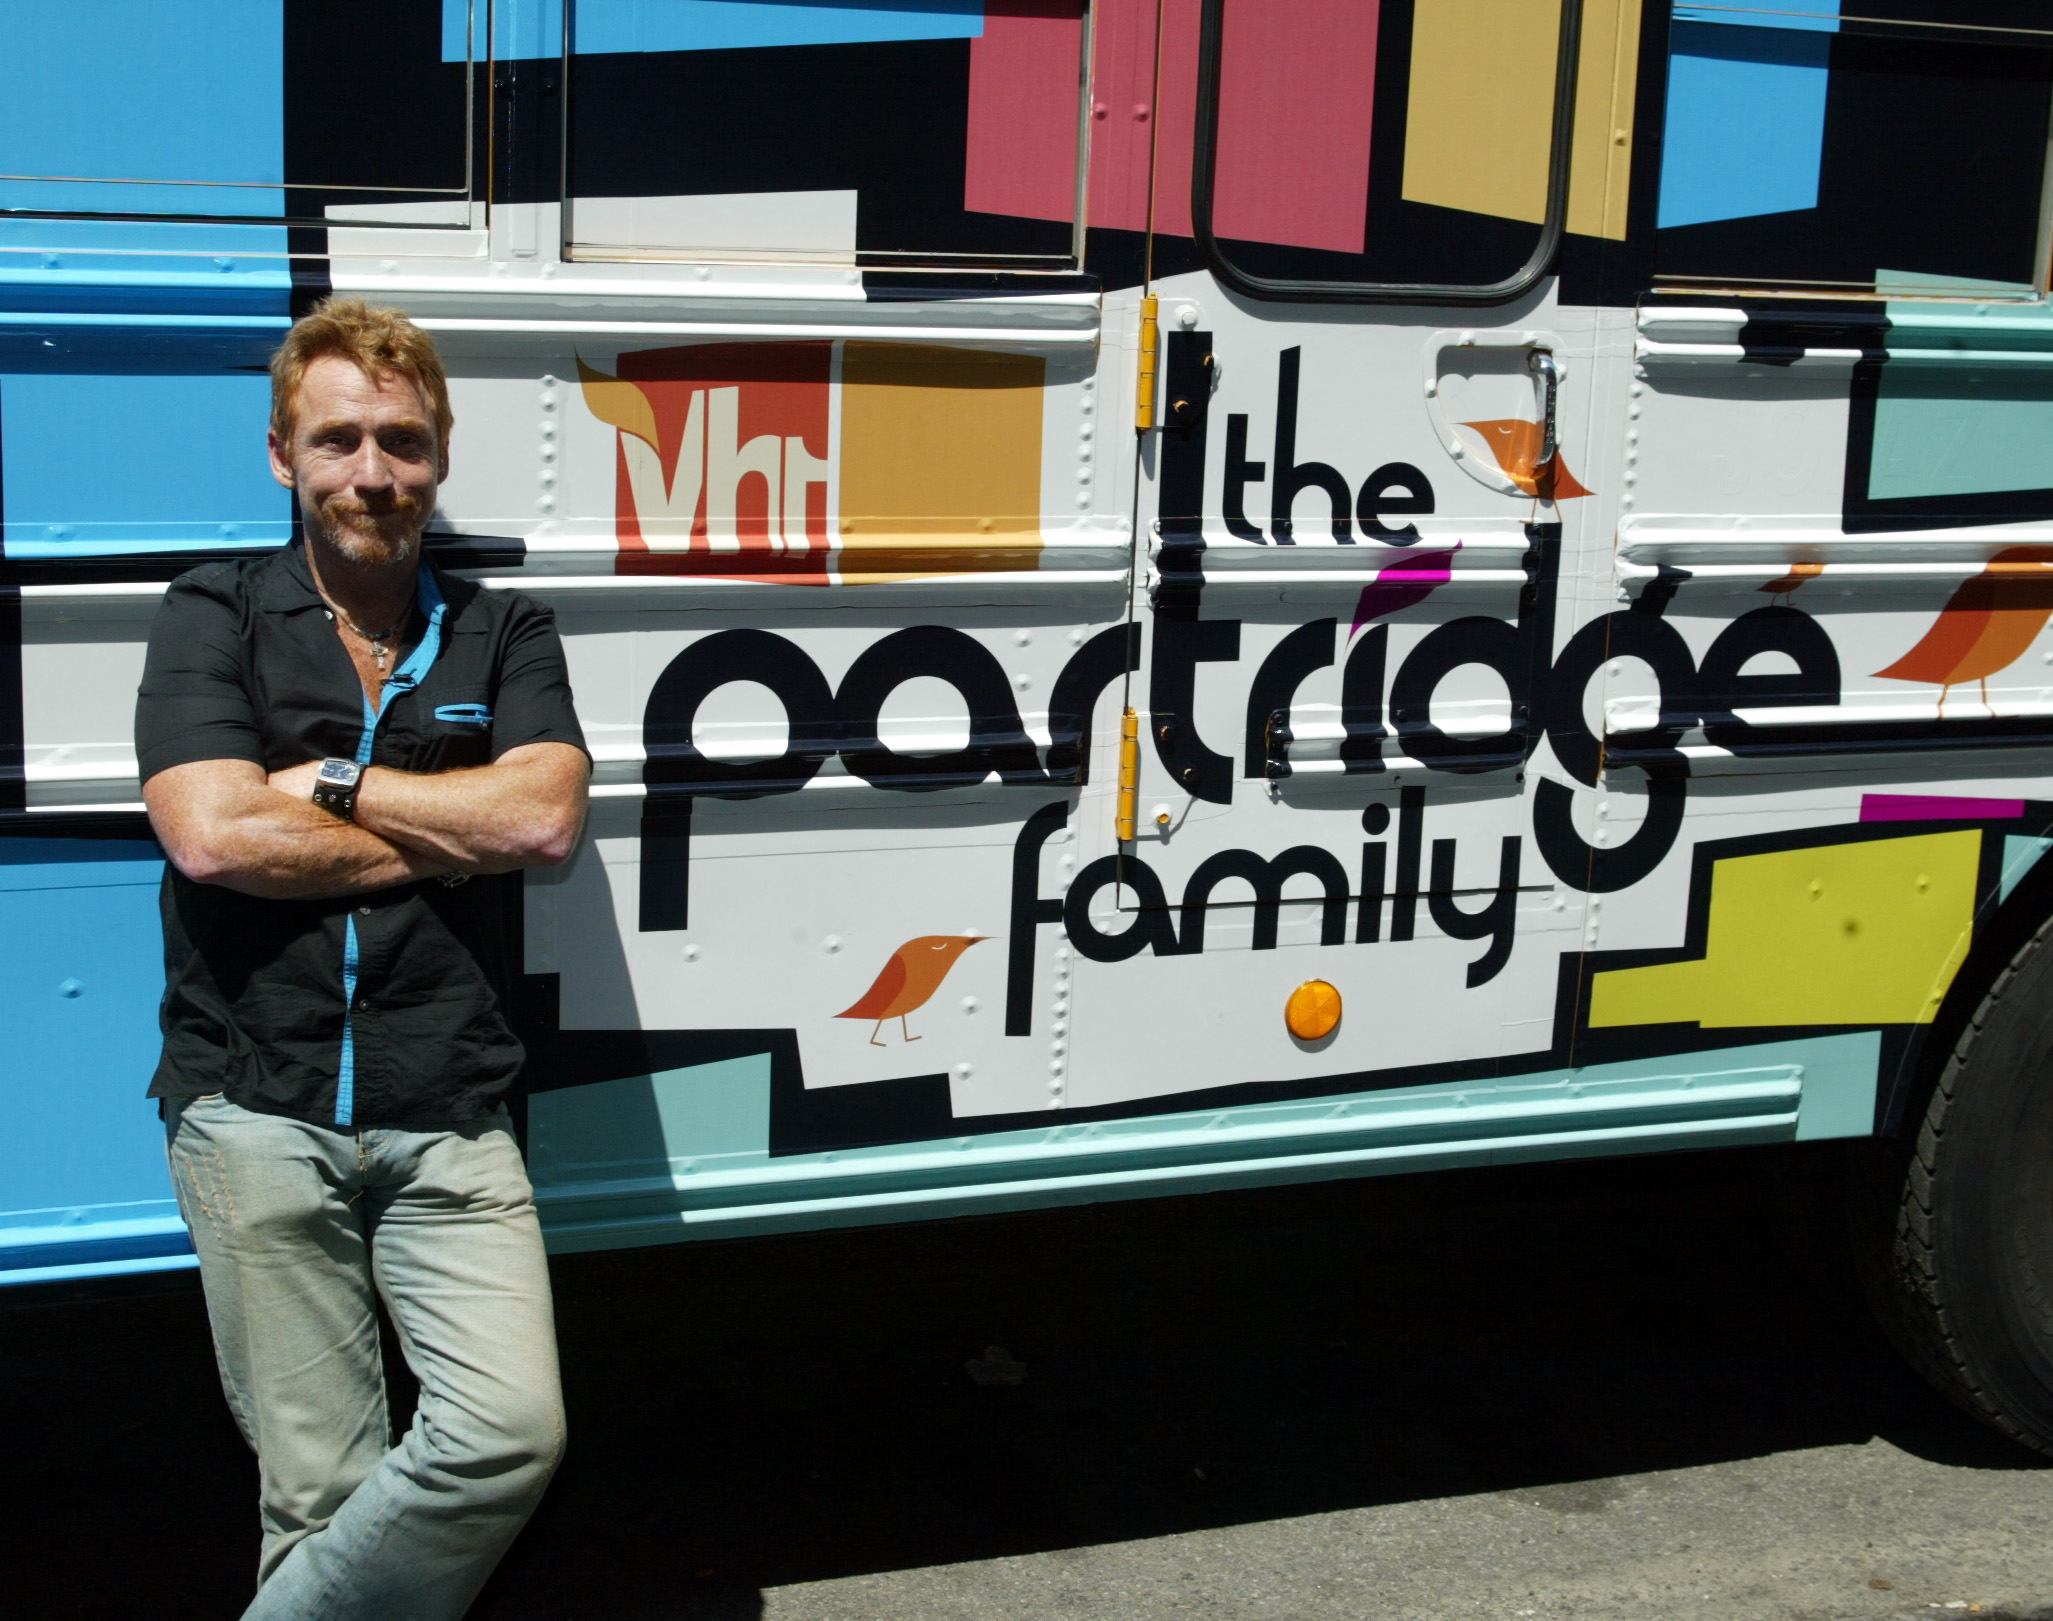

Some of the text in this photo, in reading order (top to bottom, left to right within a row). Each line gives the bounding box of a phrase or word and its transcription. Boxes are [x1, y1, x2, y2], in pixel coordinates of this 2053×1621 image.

[1221, 345, 1436, 546] the
[639, 331, 1842, 932] partridge
[1004, 786, 1522, 1037] family
